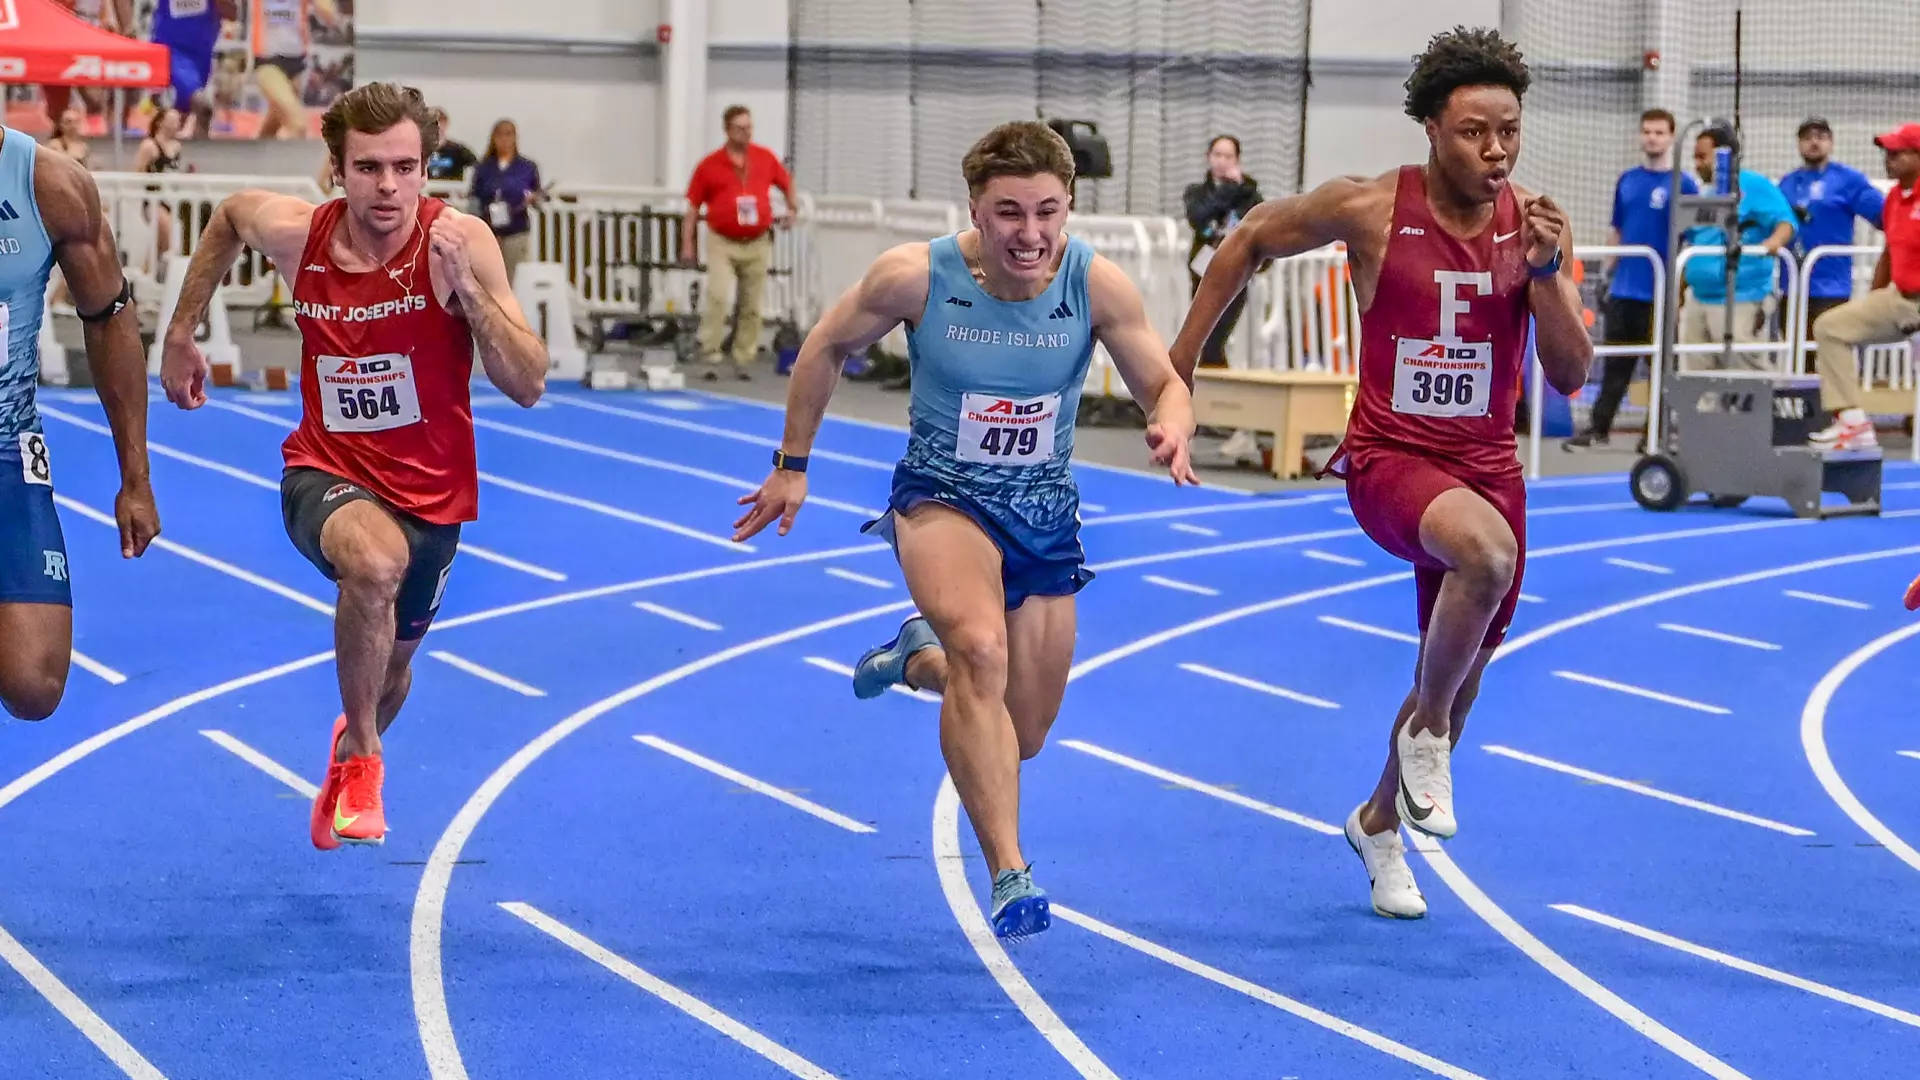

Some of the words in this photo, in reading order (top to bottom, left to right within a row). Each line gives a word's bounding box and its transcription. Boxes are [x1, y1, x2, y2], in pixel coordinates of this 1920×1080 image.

[61, 55, 151, 80] A10
[1399, 226, 1425, 236] A10
[294, 299, 341, 321] SAINT
[342, 295, 427, 322] JOSEPH'S
[945, 296, 973, 308] A10
[1434, 269, 1493, 343] F
[945, 324, 1002, 345] RHODE
[1007, 332, 1070, 348] ISLAND
[1417, 343, 1477, 359] A10
[335, 360, 391, 374] A10
[1403, 357, 1486, 370] CHAMPIONSHIPS
[324, 371, 406, 385] CHAMPIONSHIPS
[1412, 371, 1474, 405] 396
[337, 386, 400, 419] 564
[984, 400, 1044, 415] A10
[968, 411, 1053, 425] CHAMPIONSHIPS
[980, 427, 1038, 456] 479
[28, 435, 49, 481] 8
